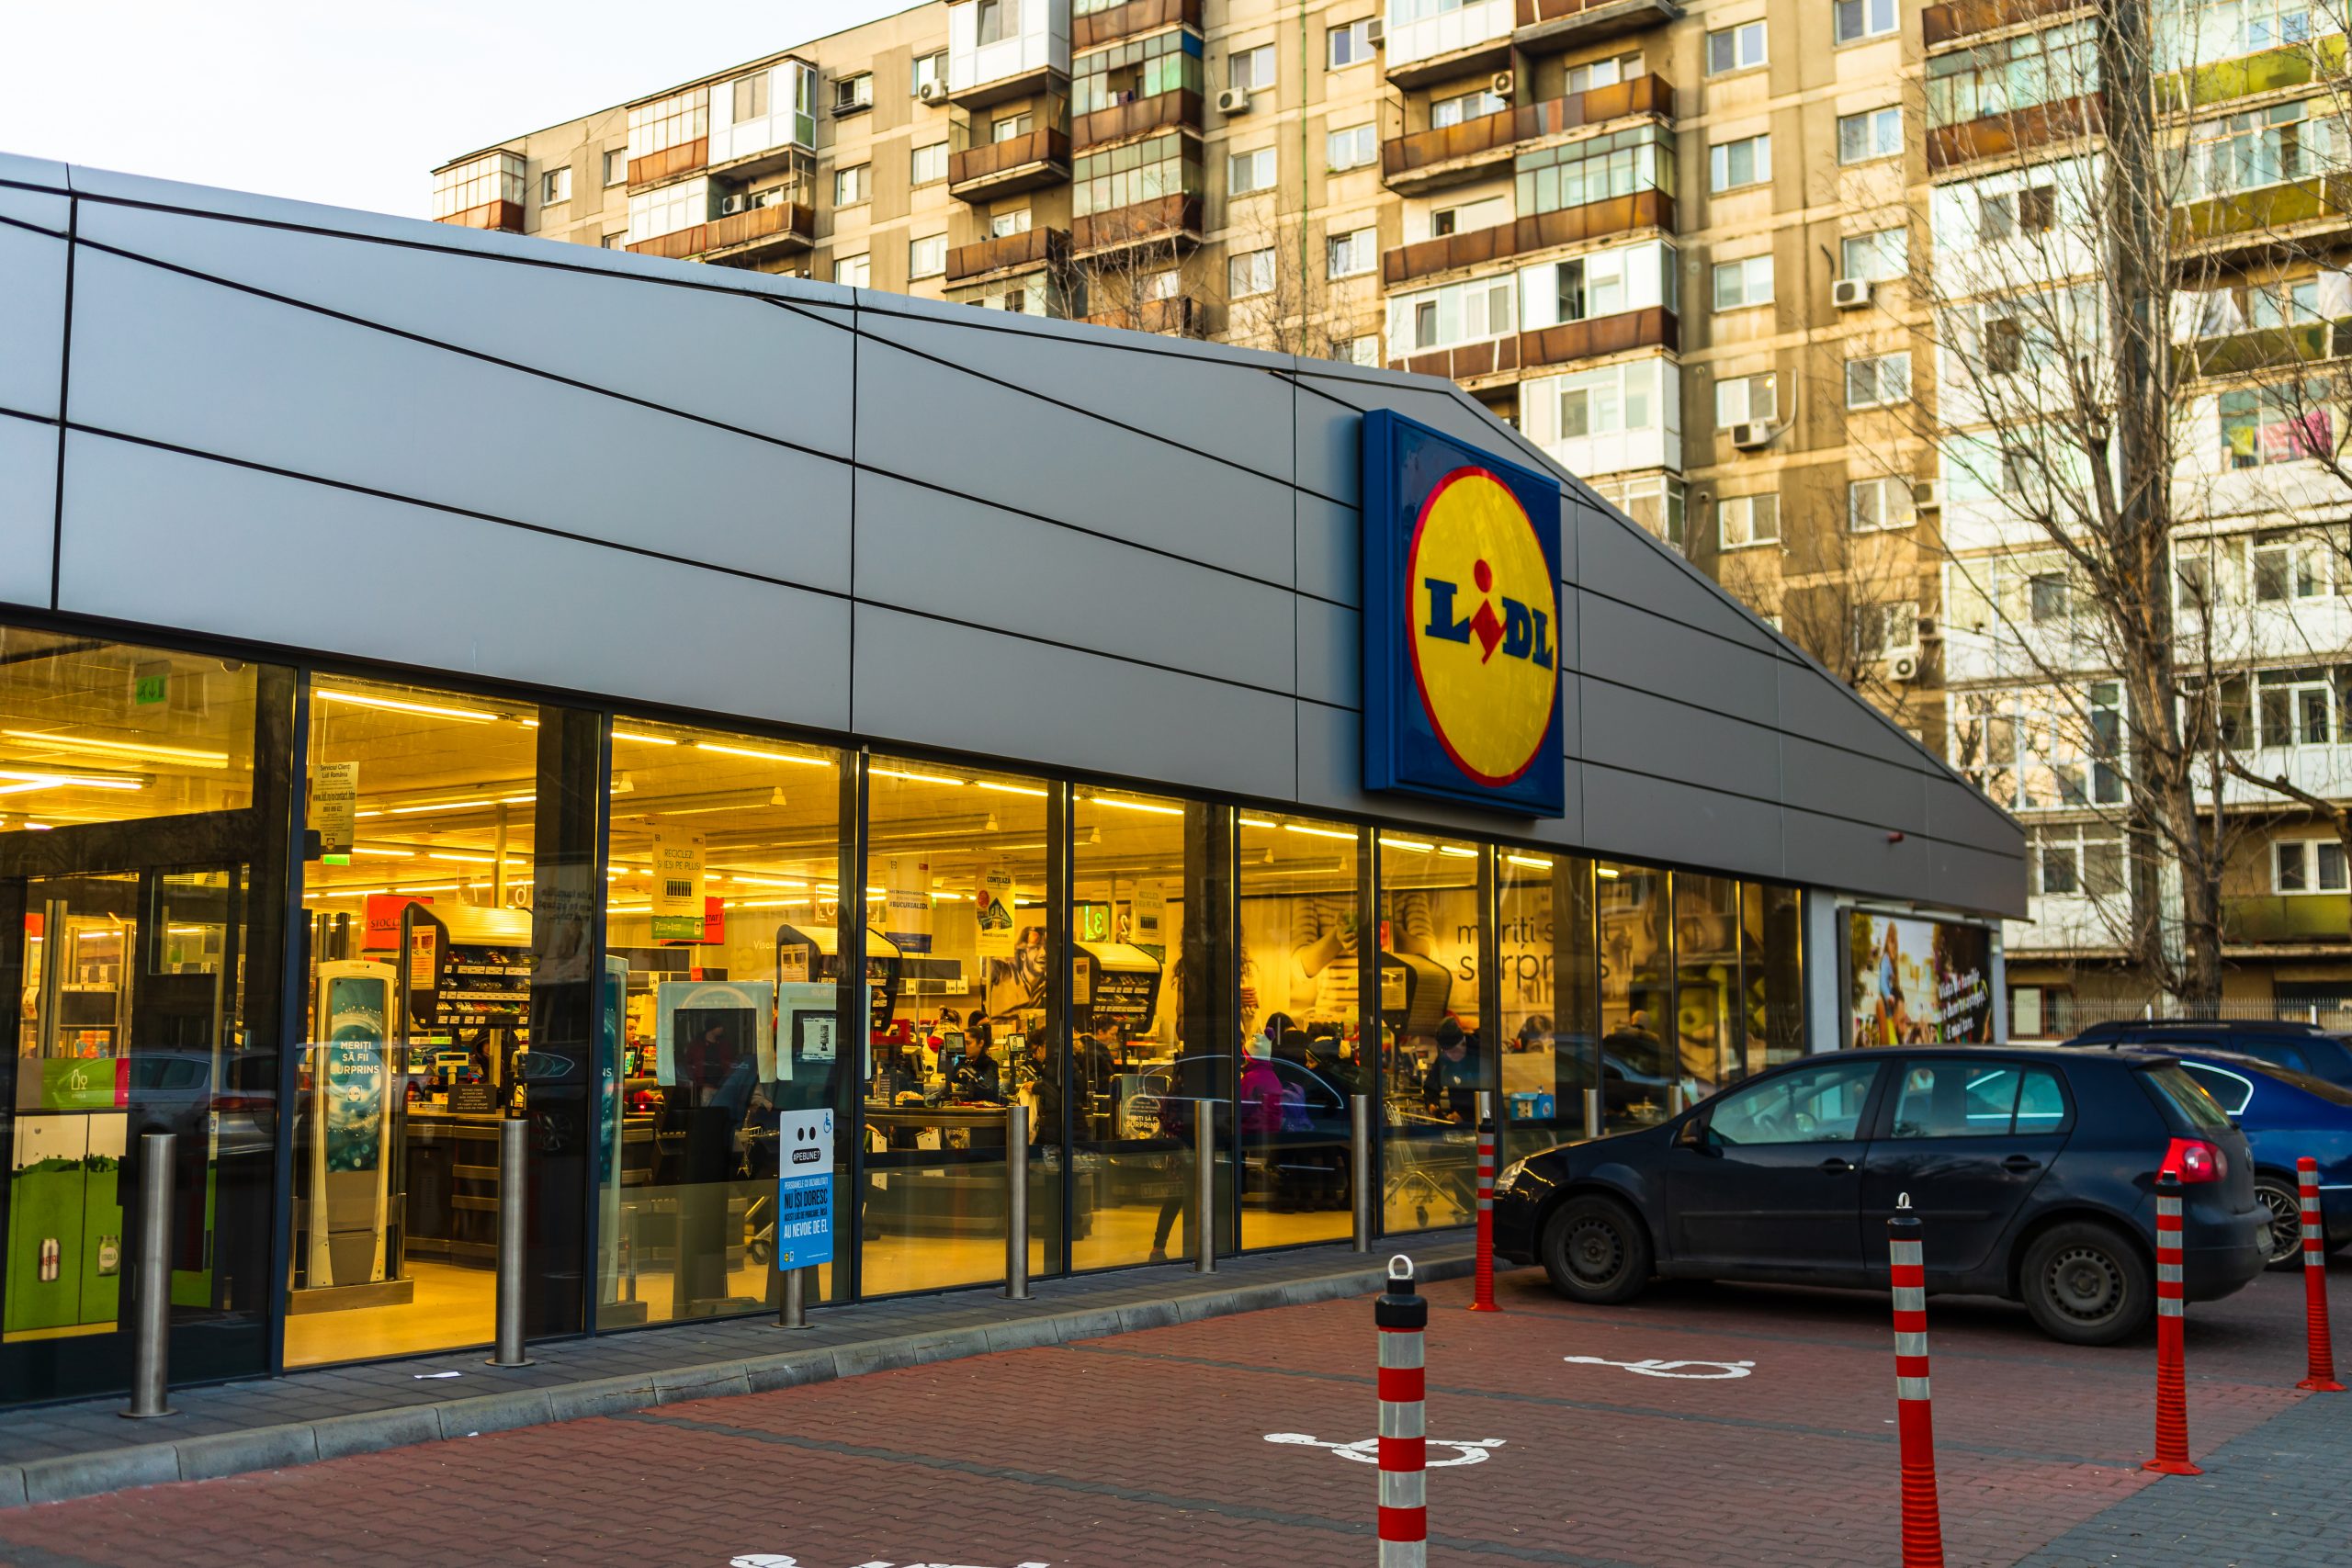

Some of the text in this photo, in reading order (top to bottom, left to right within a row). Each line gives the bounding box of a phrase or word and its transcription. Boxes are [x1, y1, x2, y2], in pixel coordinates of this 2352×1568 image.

[1425, 558, 1553, 671] LIDL
[1458, 917, 1536, 950] mriți
[341, 1041, 371, 1052] MERIȚI
[343, 1051, 368, 1061] SĂ FII
[793, 1150, 820, 1162] #PEBUNE?
[785, 1192, 793, 1210] NU
[804, 1189, 828, 1206] DORESC
[784, 1218, 828, 1239] AU NEVOIE DE EL
